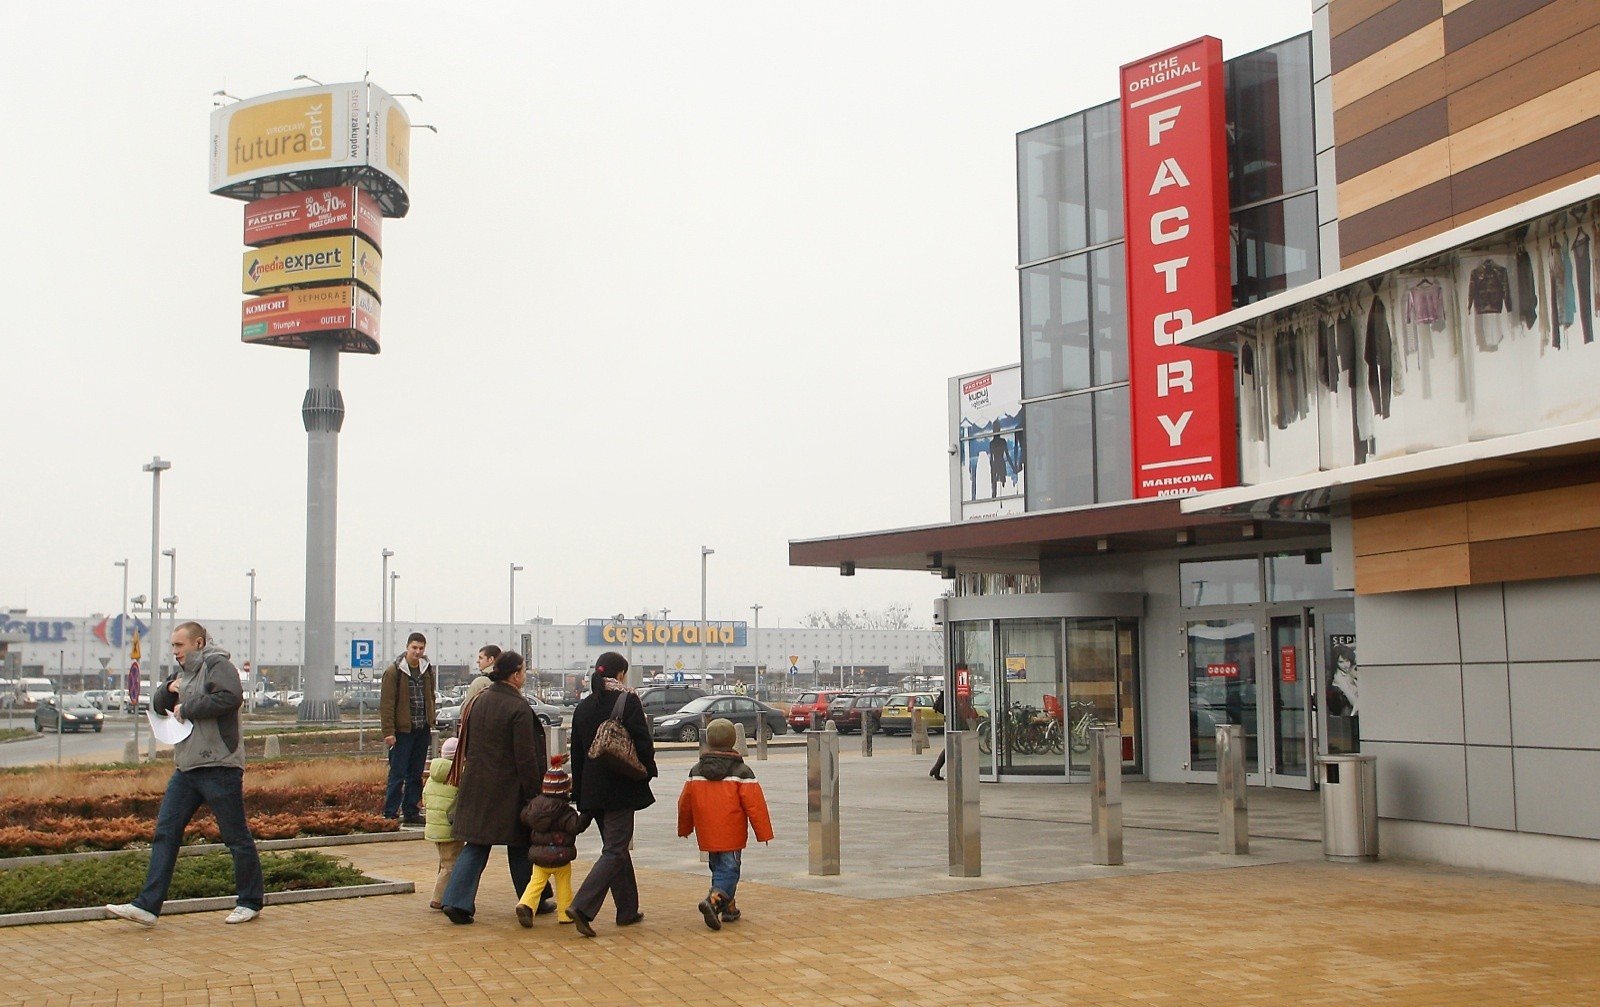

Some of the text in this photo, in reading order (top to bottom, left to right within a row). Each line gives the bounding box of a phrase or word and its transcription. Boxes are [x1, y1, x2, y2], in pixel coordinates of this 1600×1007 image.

[1149, 56, 1178, 74] THE
[1129, 61, 1201, 92] ORIGINAL
[305, 104, 325, 151] park
[235, 133, 307, 165] futura
[248, 209, 298, 226] FACTORY
[1149, 105, 1193, 447] FACTORY
[298, 291, 340, 303] SEPHORA
[246, 300, 287, 314] KOMFORT
[273, 320, 297, 331] Triumph
[321, 315, 346, 325] OUTLET
[1142, 473, 1214, 488] MARKOWA
[602, 621, 735, 644] castorama
[356, 642, 370, 660] P
